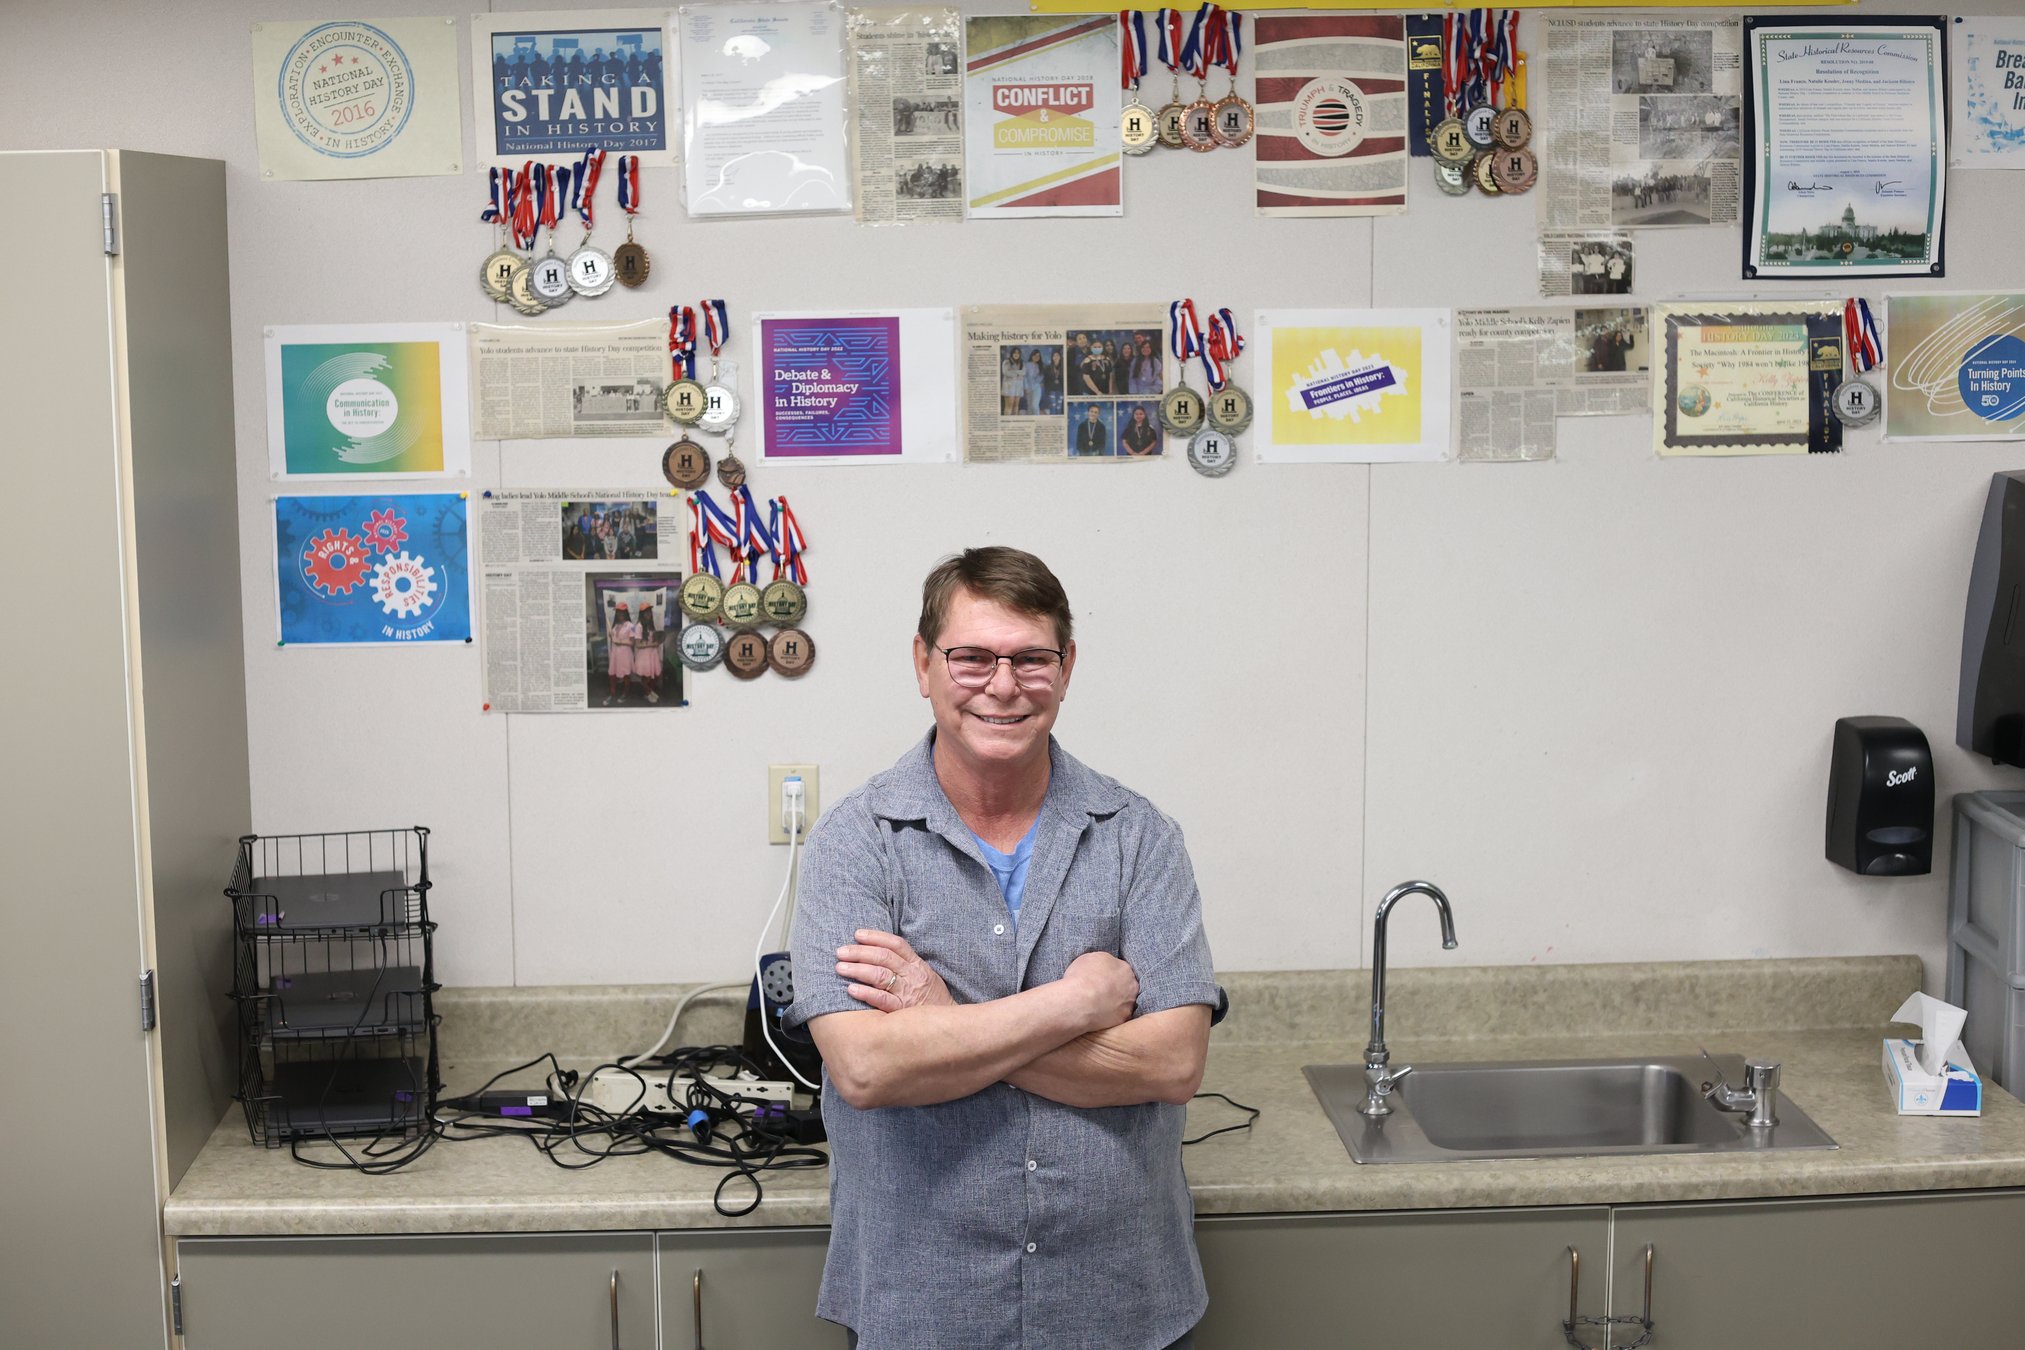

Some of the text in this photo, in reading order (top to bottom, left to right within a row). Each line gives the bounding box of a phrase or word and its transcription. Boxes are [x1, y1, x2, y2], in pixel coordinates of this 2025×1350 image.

[1578, 19, 1605, 27] students
[1660, 20, 1684, 28] History
[1687, 20, 1699, 28] Day
[1701, 20, 1739, 28] competition
[1777, 42, 1918, 63] State Historical Resources Commission
[313, 66, 373, 90] NATIONAL
[500, 73, 651, 87] TAKING A
[289, 32, 404, 149] EXPLORATION ENCOUNTER EXCHANGE IN HISTORY
[309, 77, 384, 106] HISTORY DAY
[997, 87, 1090, 106] CONFLICT
[501, 86, 656, 122] STAND
[1299, 86, 1326, 128] TRIUMPH
[1339, 86, 1363, 126] TRAGEDY
[331, 100, 376, 126] 2016
[1040, 109, 1048, 122] &
[505, 121, 657, 136] IN HISTORY
[999, 127, 1090, 143] COMPROMISE
[506, 138, 657, 150] National History Day 2017
[1459, 318, 1473, 326] Yolo
[1475, 318, 1497, 326] Middle
[1529, 317, 1545, 325] Kelly
[1547, 317, 1570, 326] Zapien
[968, 330, 1062, 342] Making history for Yolo
[1490, 329, 1513, 337] county
[1702, 332, 1750, 341] HISTORY
[1751, 332, 1774, 341] DAY
[581, 345, 606, 353] History
[608, 345, 621, 353] Day
[1782, 349, 1805, 357] History
[775, 369, 831, 380] Debate &
[1306, 378, 1329, 387] NATIONAL
[1331, 372, 1351, 380] HISTORY
[1968, 368, 2025, 380] Turning Points
[792, 383, 859, 395] Diplomacy
[1310, 383, 1345, 398] Frontiers
[1353, 372, 1385, 385] History:
[1971, 380, 2011, 392] In History
[775, 396, 837, 408] in History
[1313, 385, 1369, 405] PEOPLE, PLACES, IDEAS
[1981, 394, 1999, 406] 50
[334, 399, 390, 408] Communication
[570, 491, 594, 499] School's
[622, 491, 645, 500] History
[318, 540, 354, 560] RIGHTS
[382, 562, 425, 608] RESPONSIBILITIES
[382, 620, 435, 640] IN HISTORY
[1886, 766, 1917, 787] Scott
